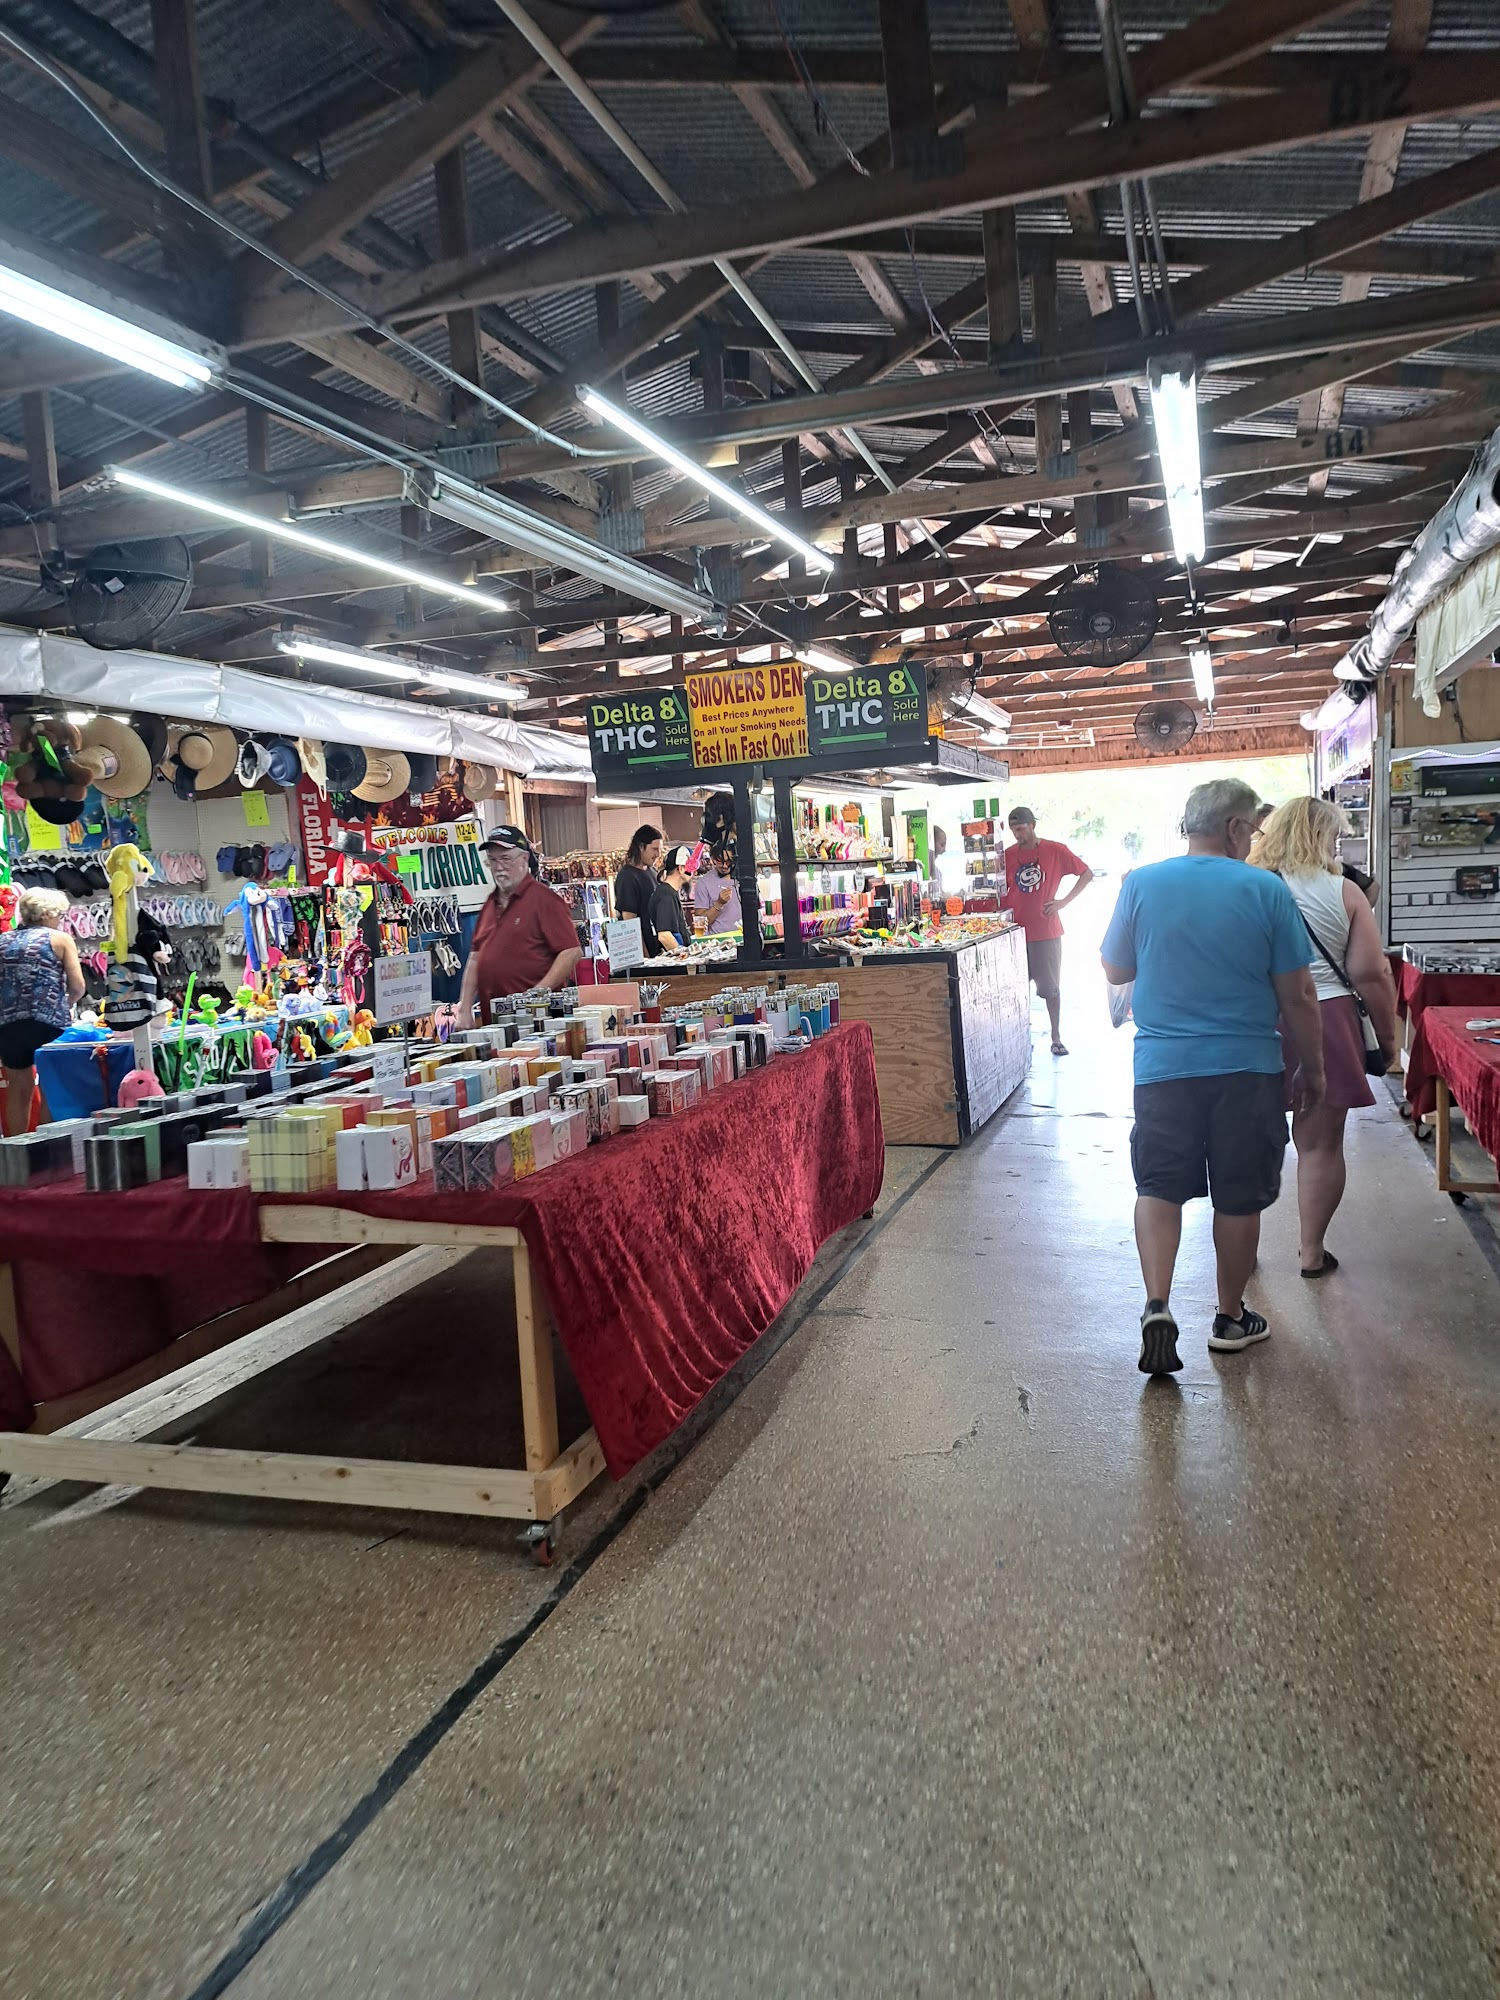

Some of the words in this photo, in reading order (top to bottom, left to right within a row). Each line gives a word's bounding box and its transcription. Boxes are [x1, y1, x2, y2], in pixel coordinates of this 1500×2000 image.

[688, 670, 766, 709] SMOKERS
[769, 665, 803, 699] DEN
[812, 676, 882, 702] Delta
[888, 670, 906, 694] 8
[591, 702, 655, 727] Delta
[659, 697, 676, 720] 8
[702, 712, 721, 722] Best
[723, 709, 750, 720] Prices
[752, 705, 795, 718] Anywhere
[815, 699, 883, 729] THC
[893, 698, 918, 711] Sold
[893, 712, 920, 722] Here
[595, 724, 657, 752] THC
[665, 724, 688, 736] Sold
[693, 728, 705, 737] On
[707, 726, 717, 736] all
[719, 725, 738, 734] Your
[740, 720, 777, 732] Smoking
[779, 717, 806, 728] Needs
[665, 737, 690, 746] Here
[694, 739, 722, 766] Fast
[724, 738, 738, 762] In
[740, 734, 769, 761] Fast
[772, 731, 795, 757] Out
[798, 729, 807, 754] !!
[301, 792, 328, 875] FLORIDA
[375, 826, 449, 848] WELCOME
